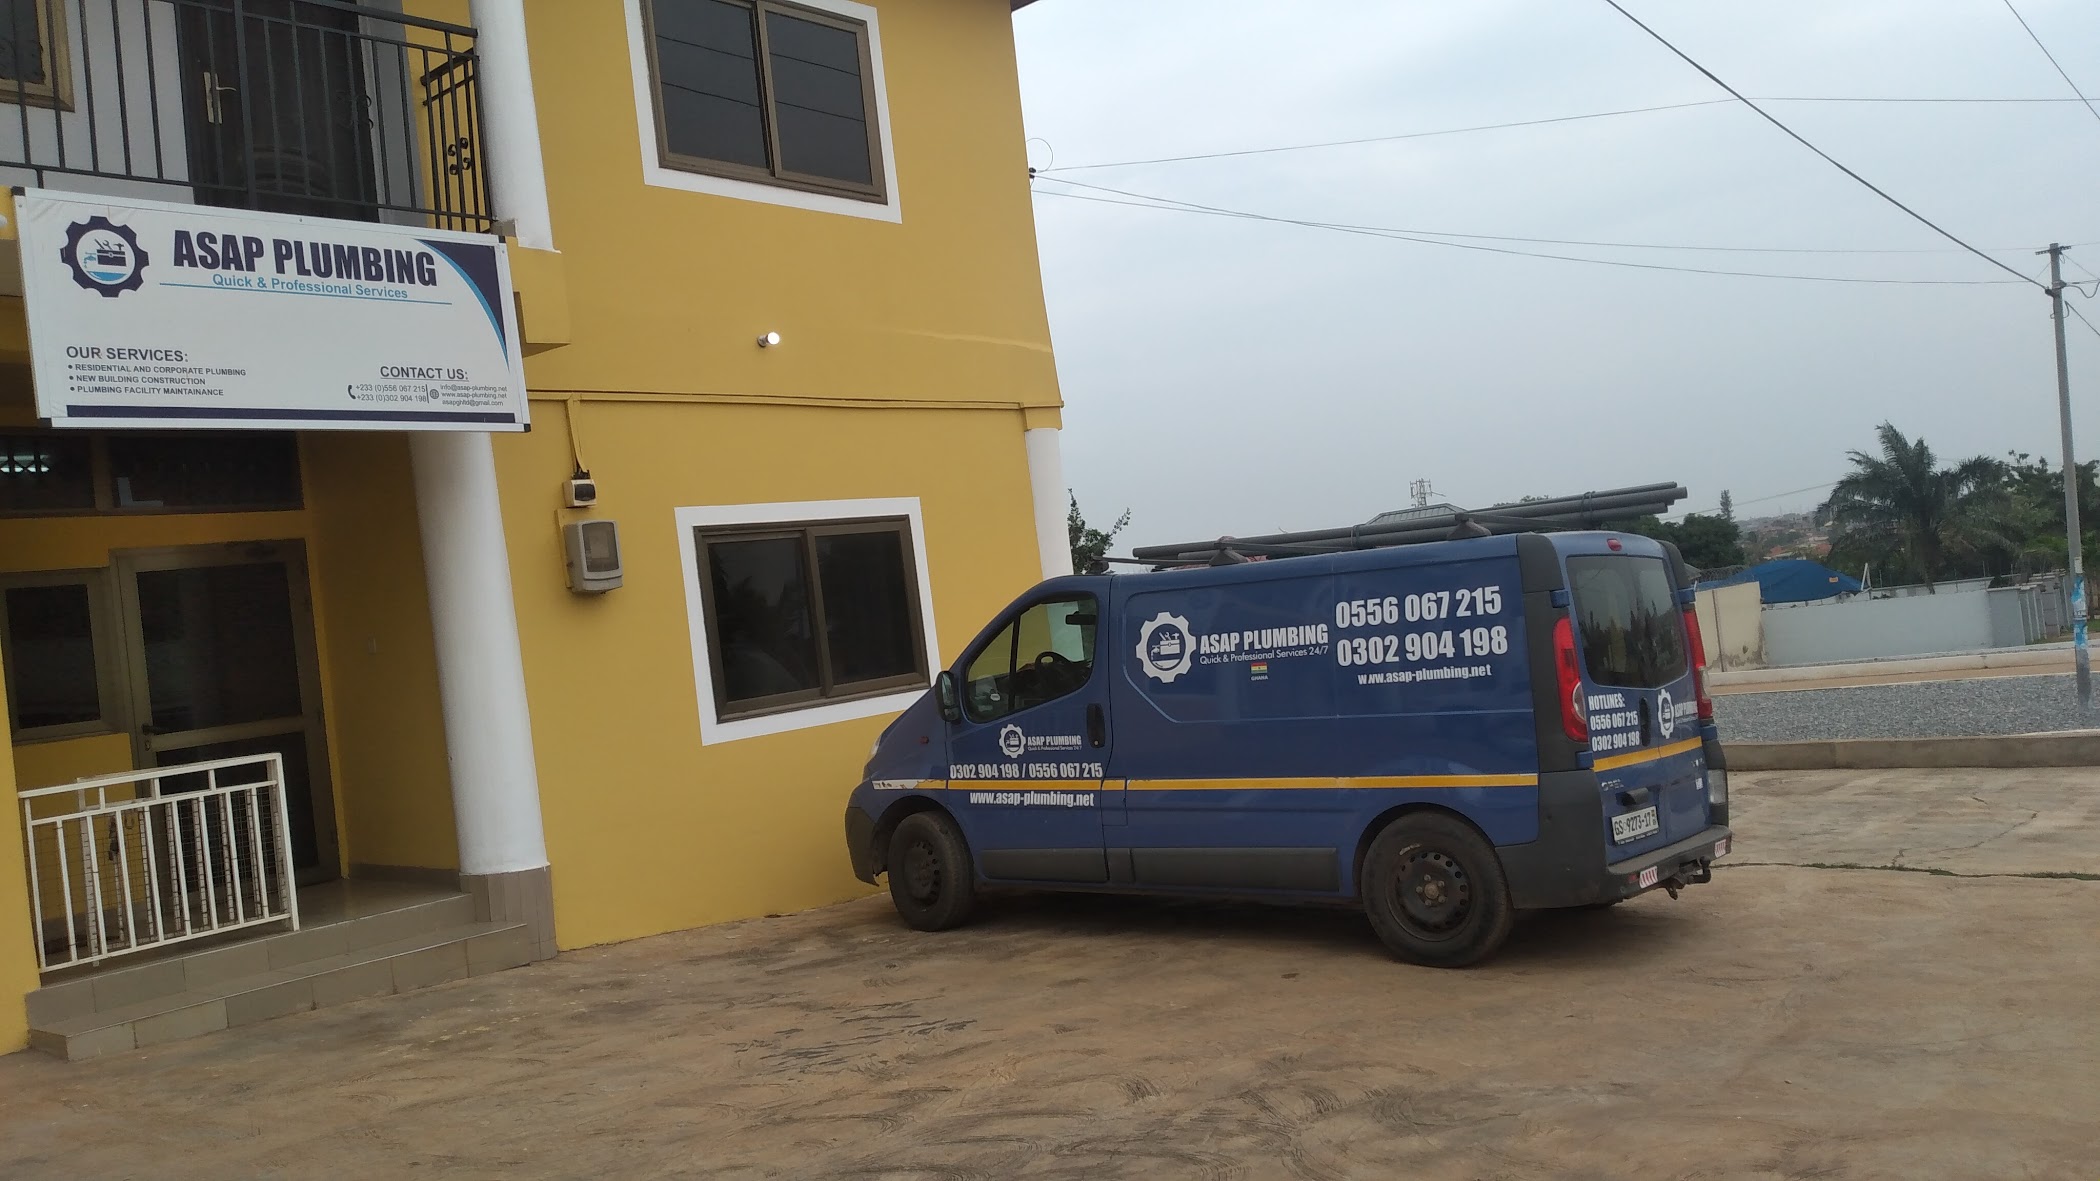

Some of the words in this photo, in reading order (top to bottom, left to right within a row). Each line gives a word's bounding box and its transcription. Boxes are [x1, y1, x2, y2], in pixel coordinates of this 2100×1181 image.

[174, 230, 264, 272] ASAP
[273, 238, 438, 286] PLUMBING
[212, 273, 252, 288] Quick
[257, 276, 267, 288] &
[272, 278, 352, 294] Professional
[355, 284, 408, 299] Services
[66, 346, 102, 359] OUR
[106, 348, 189, 362] SERVICES:
[75, 364, 131, 372] RESIDENTIAL
[133, 365, 151, 373] AND
[153, 366, 203, 375] CORPORATE
[206, 368, 246, 376] PLUMBING
[380, 366, 443, 379] CONTACT
[447, 368, 468, 380] US:
[141, 376, 206, 385] CONSTRUCTION
[374, 384, 398, 392] (0)556
[77, 386, 122, 394] PLUMBING
[125, 387, 161, 395] FACILITY
[163, 388, 224, 396] MAINTAINANCE
[376, 394, 398, 402] (0)302
[1336, 596, 1399, 628] 0556
[1404, 591, 1450, 622] 067
[1455, 586, 1502, 617] 215
[1200, 632, 1240, 654] ASAP
[1243, 624, 1328, 650] PLUMBING
[1337, 635, 1399, 666] 0302
[1405, 630, 1455, 661] 904
[1459, 625, 1508, 656] 198
[1200, 655, 1221, 664] Quick
[1223, 654, 1229, 662] &
[1230, 650, 1274, 662] Professional
[1277, 648, 1307, 658] Services
[1309, 646, 1328, 656] 24/7
[1358, 664, 1492, 685] www.asap-plumbing.net
[1588, 693, 1625, 710] HOTLINES:
[1590, 714, 1611, 730] 0556
[1612, 712, 1625, 728] 067
[1626, 711, 1638, 726] 215
[1028, 736, 1044, 746] ASAP
[1046, 735, 1081, 746] PLUMBING
[1592, 735, 1612, 752] 0302
[1613, 733, 1627, 748] 904
[1628, 731, 1639, 746] 198
[950, 765, 976, 779] 0302
[978, 764, 999, 778] 904
[1000, 763, 1019, 778] 198
[1022, 763, 1026, 778] /
[1029, 763, 1057, 778] 0556
[1060, 763, 1079, 778] 067
[1082, 762, 1103, 778] 215
[970, 791, 1094, 807] www.asap-plumbing.net
[1614, 819, 1624, 836] GS
[1627, 811, 1651, 832] 9273-17
